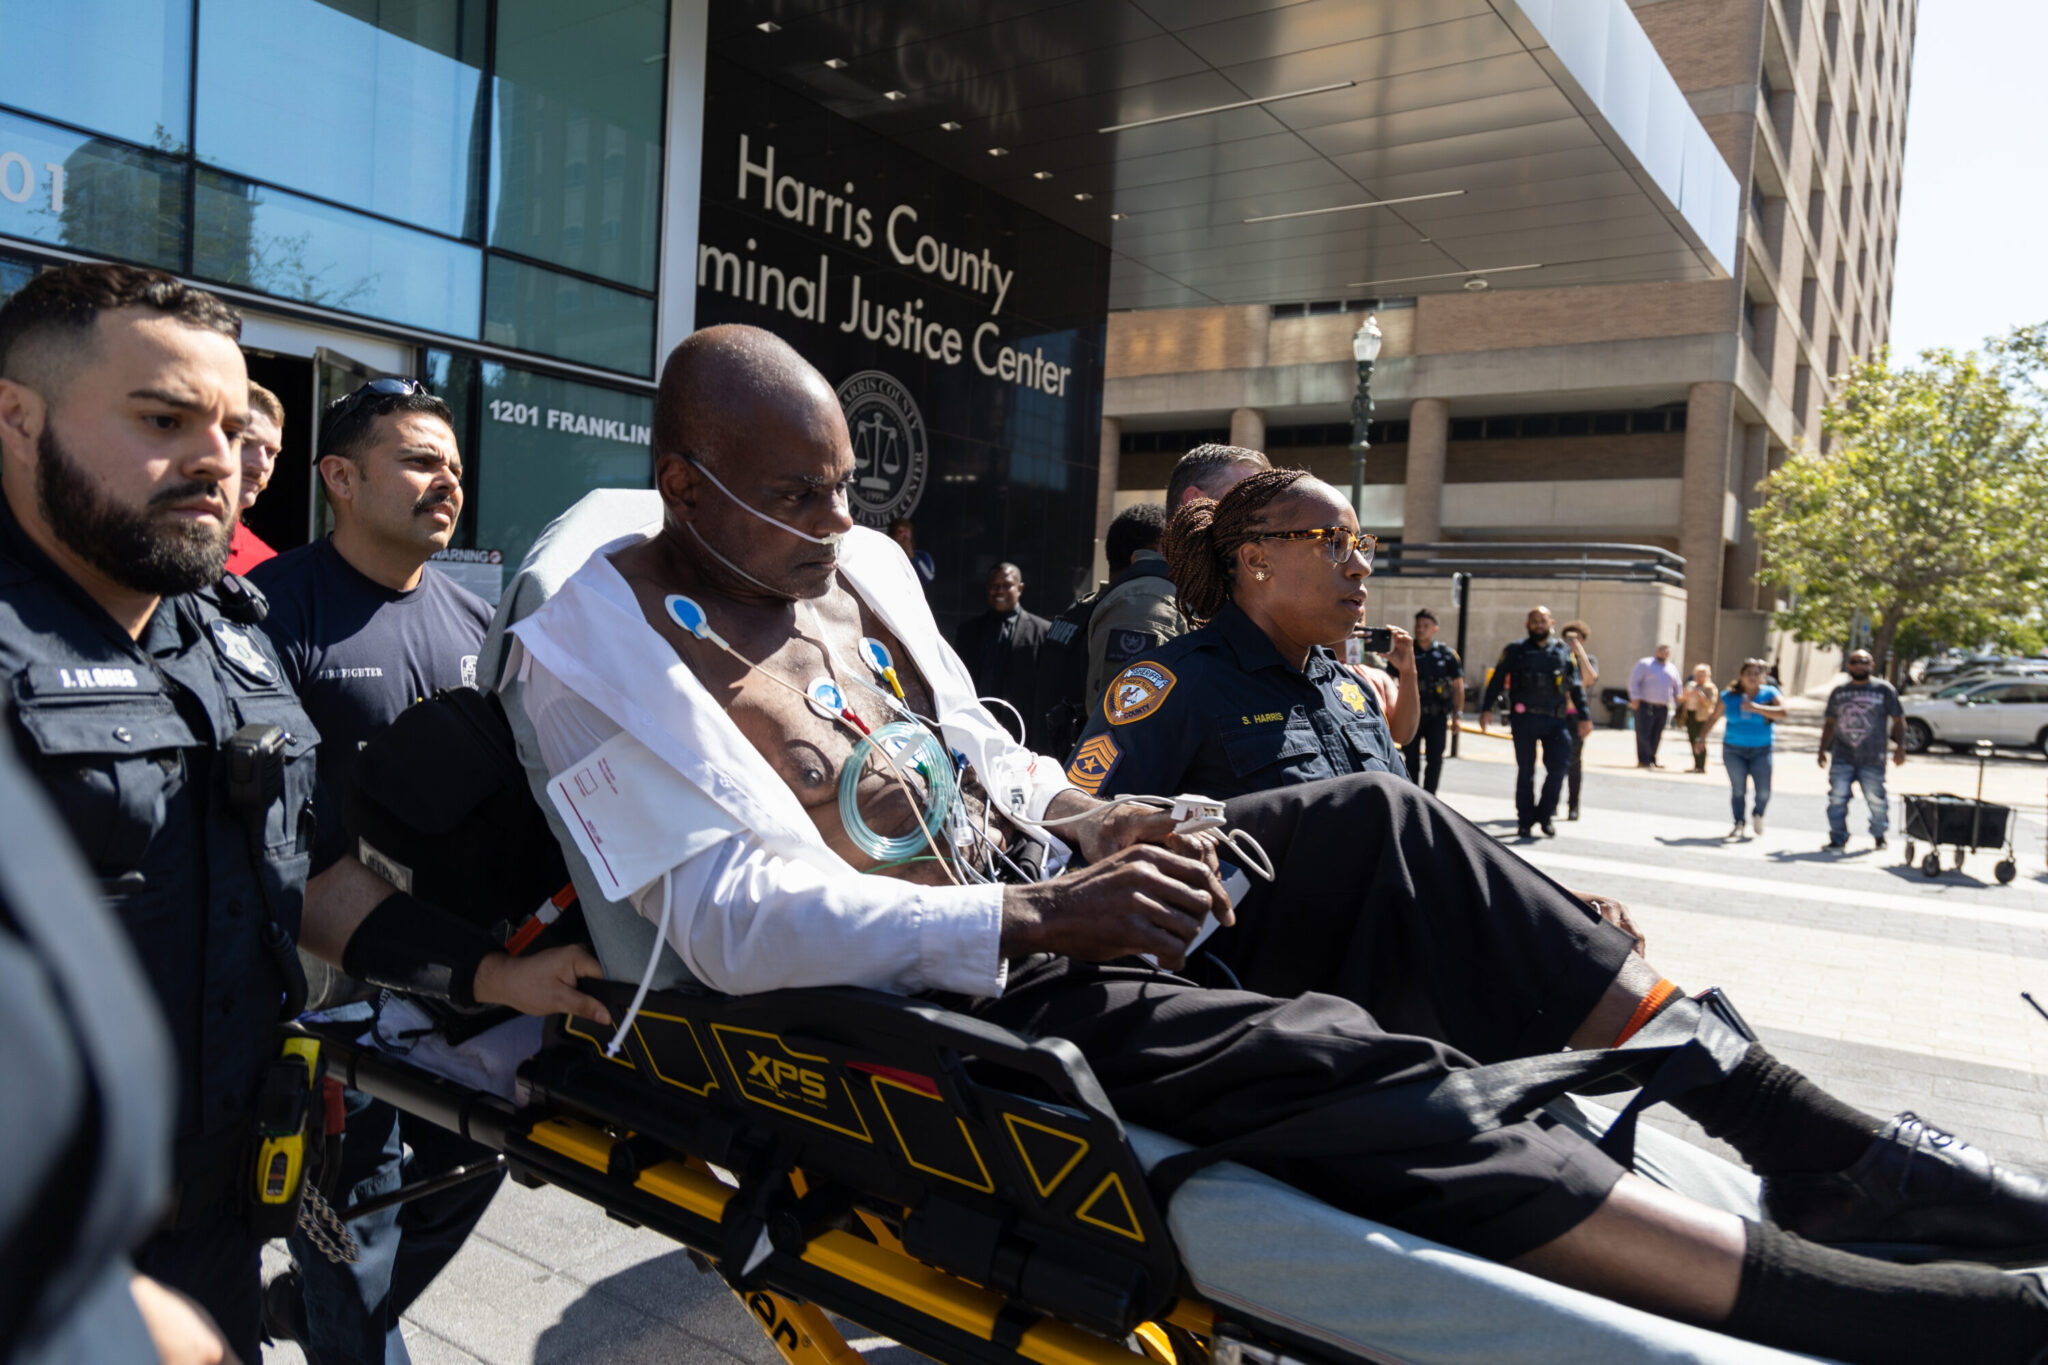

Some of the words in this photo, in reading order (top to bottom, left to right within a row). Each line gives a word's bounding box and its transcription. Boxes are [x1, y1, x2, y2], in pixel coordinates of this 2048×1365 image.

[738, 133, 873, 248] Harris
[887, 204, 1014, 316] County
[698, 238, 828, 324] minal
[840, 275, 963, 365] Justice
[972, 321, 1071, 397] Center
[488, 399, 539, 427] 1201
[546, 408, 652, 446] FRANKLIN
[1241, 715, 1252, 725] S.
[1253, 712, 1284, 724] HARRIS
[746, 1049, 827, 1100] XPS
